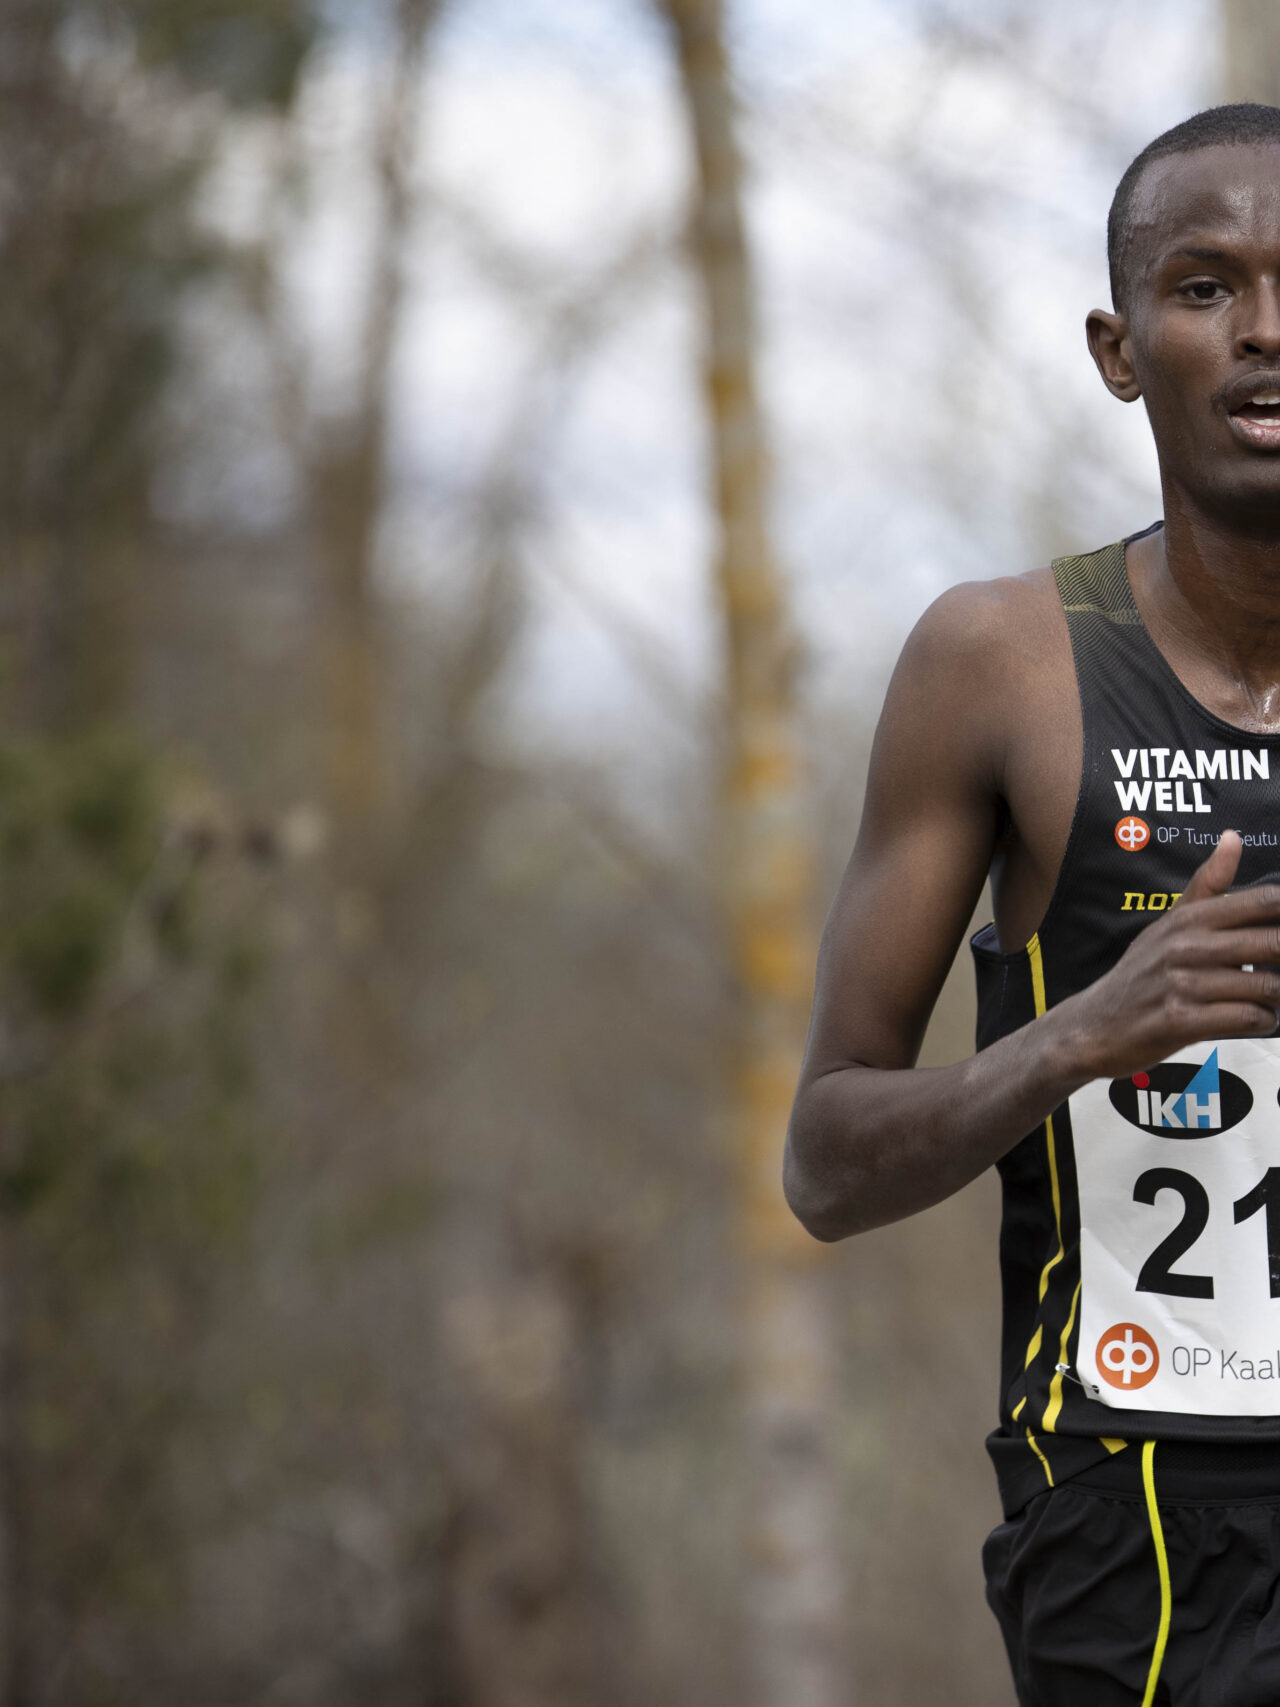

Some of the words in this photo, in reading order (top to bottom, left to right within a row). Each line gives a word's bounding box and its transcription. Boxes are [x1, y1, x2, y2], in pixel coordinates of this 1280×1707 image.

[1111, 748, 1270, 780] VITAMIN
[1114, 781, 1212, 813] WELL
[1157, 826, 1180, 843] OP
[1184, 828, 1225, 846] Turu
[1172, 1346, 1211, 1376] OP
